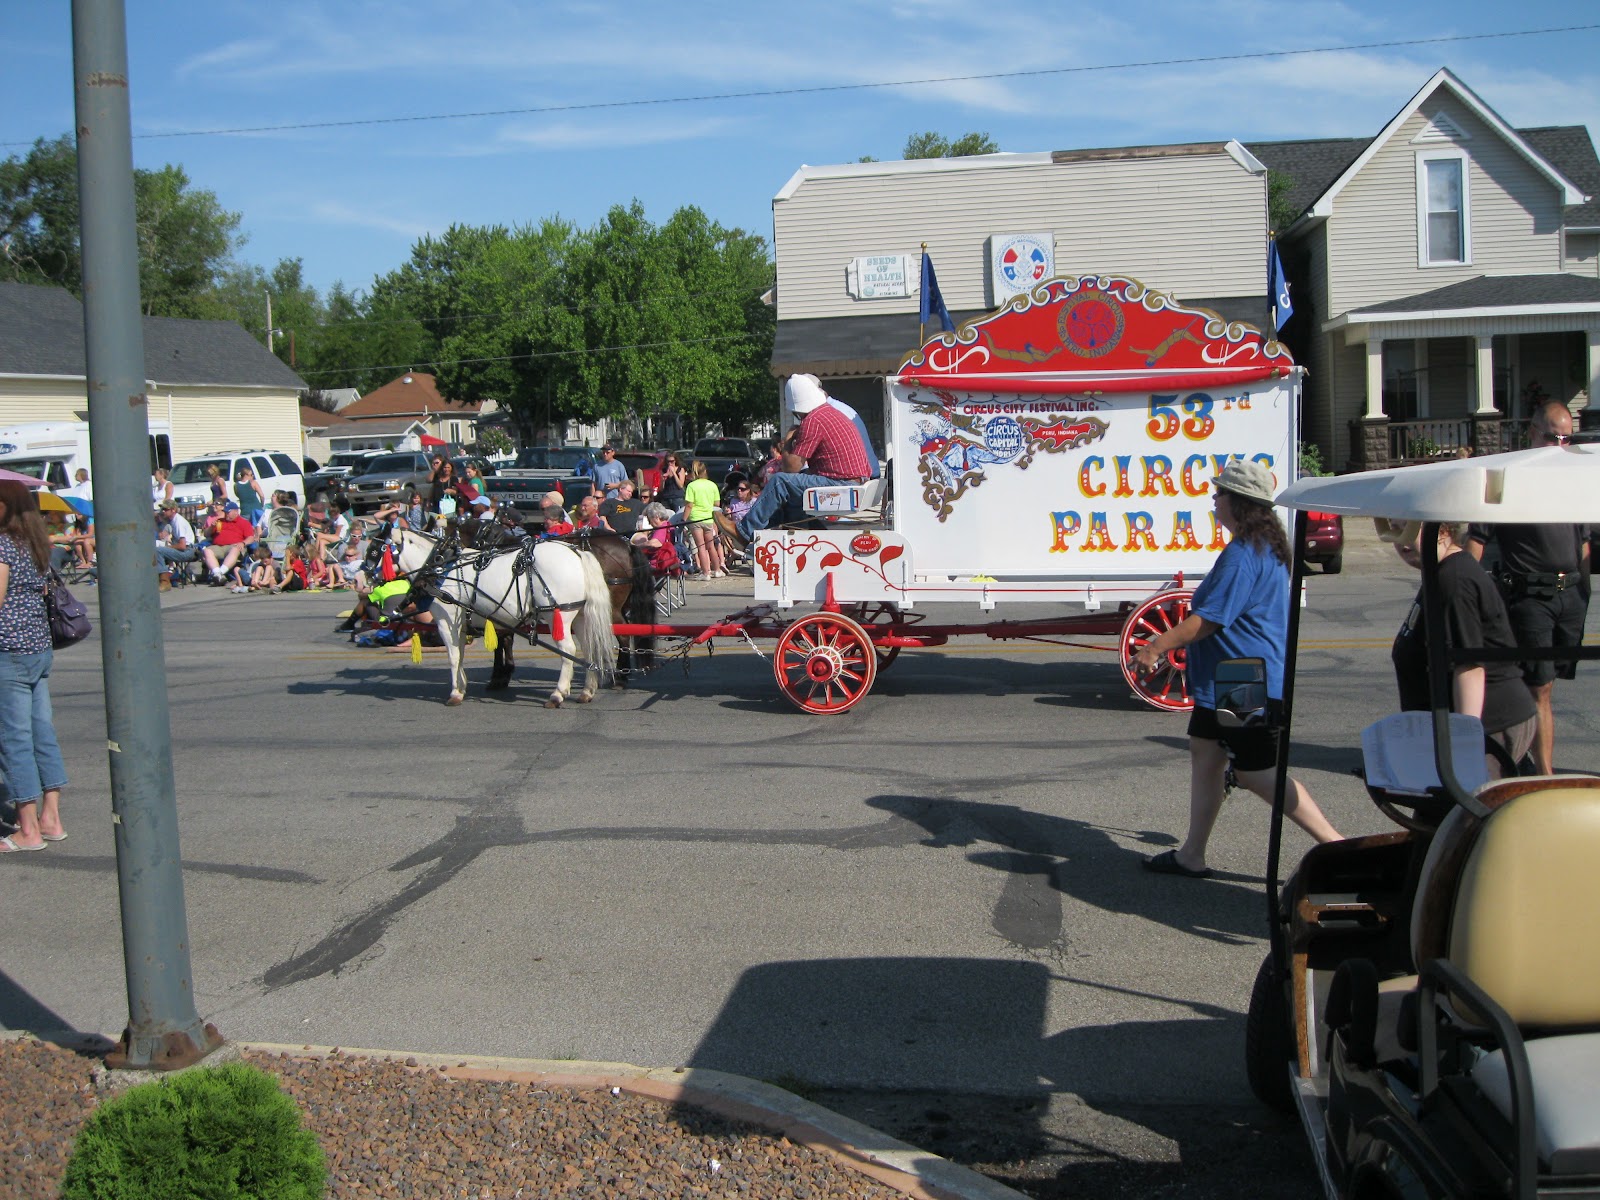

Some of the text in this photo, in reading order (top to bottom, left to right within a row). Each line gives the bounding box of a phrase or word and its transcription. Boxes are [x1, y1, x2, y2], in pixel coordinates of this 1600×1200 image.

[866, 256, 896, 266] SEEDS
[864, 272, 902, 282] HEALTH
[964, 402, 1099, 414] CIRCUS CITY FESTIVAL INC.
[988, 424, 1019, 436] CIRCUS
[989, 438, 1018, 448] CAPITAL
